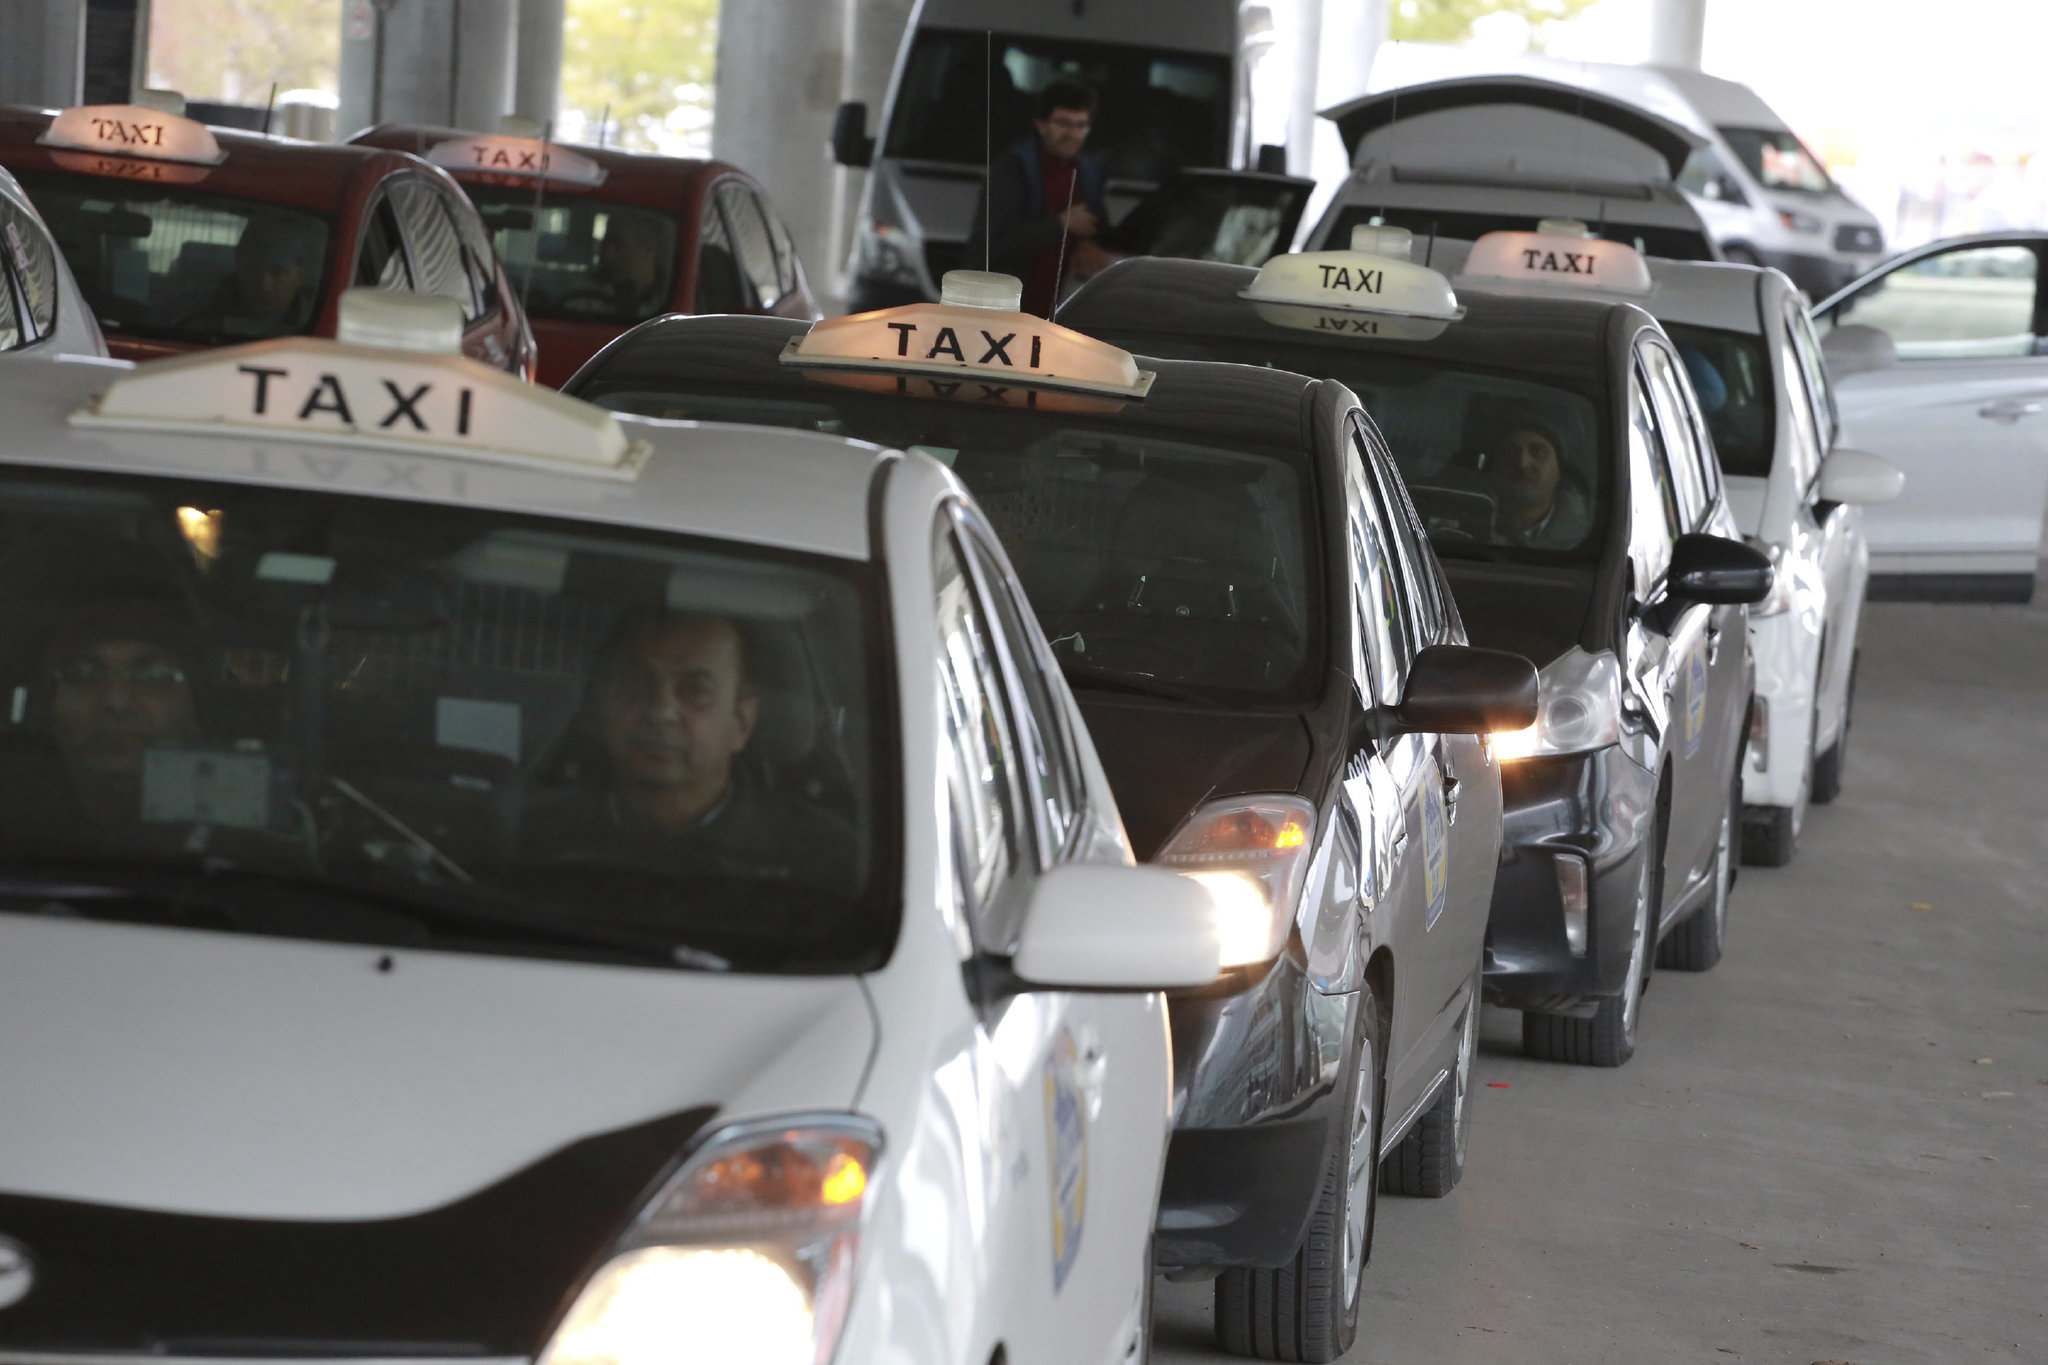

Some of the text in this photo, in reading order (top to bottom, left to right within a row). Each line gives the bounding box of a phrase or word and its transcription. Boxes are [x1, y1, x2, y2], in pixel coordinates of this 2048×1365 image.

[91, 117, 164, 147] TAXI
[473, 146, 550, 170] TAXI
[1523, 248, 1594, 275] TAXI
[1318, 264, 1383, 294] TAXI
[887, 322, 1041, 369] TAXI
[238, 364, 472, 436] TAXI
